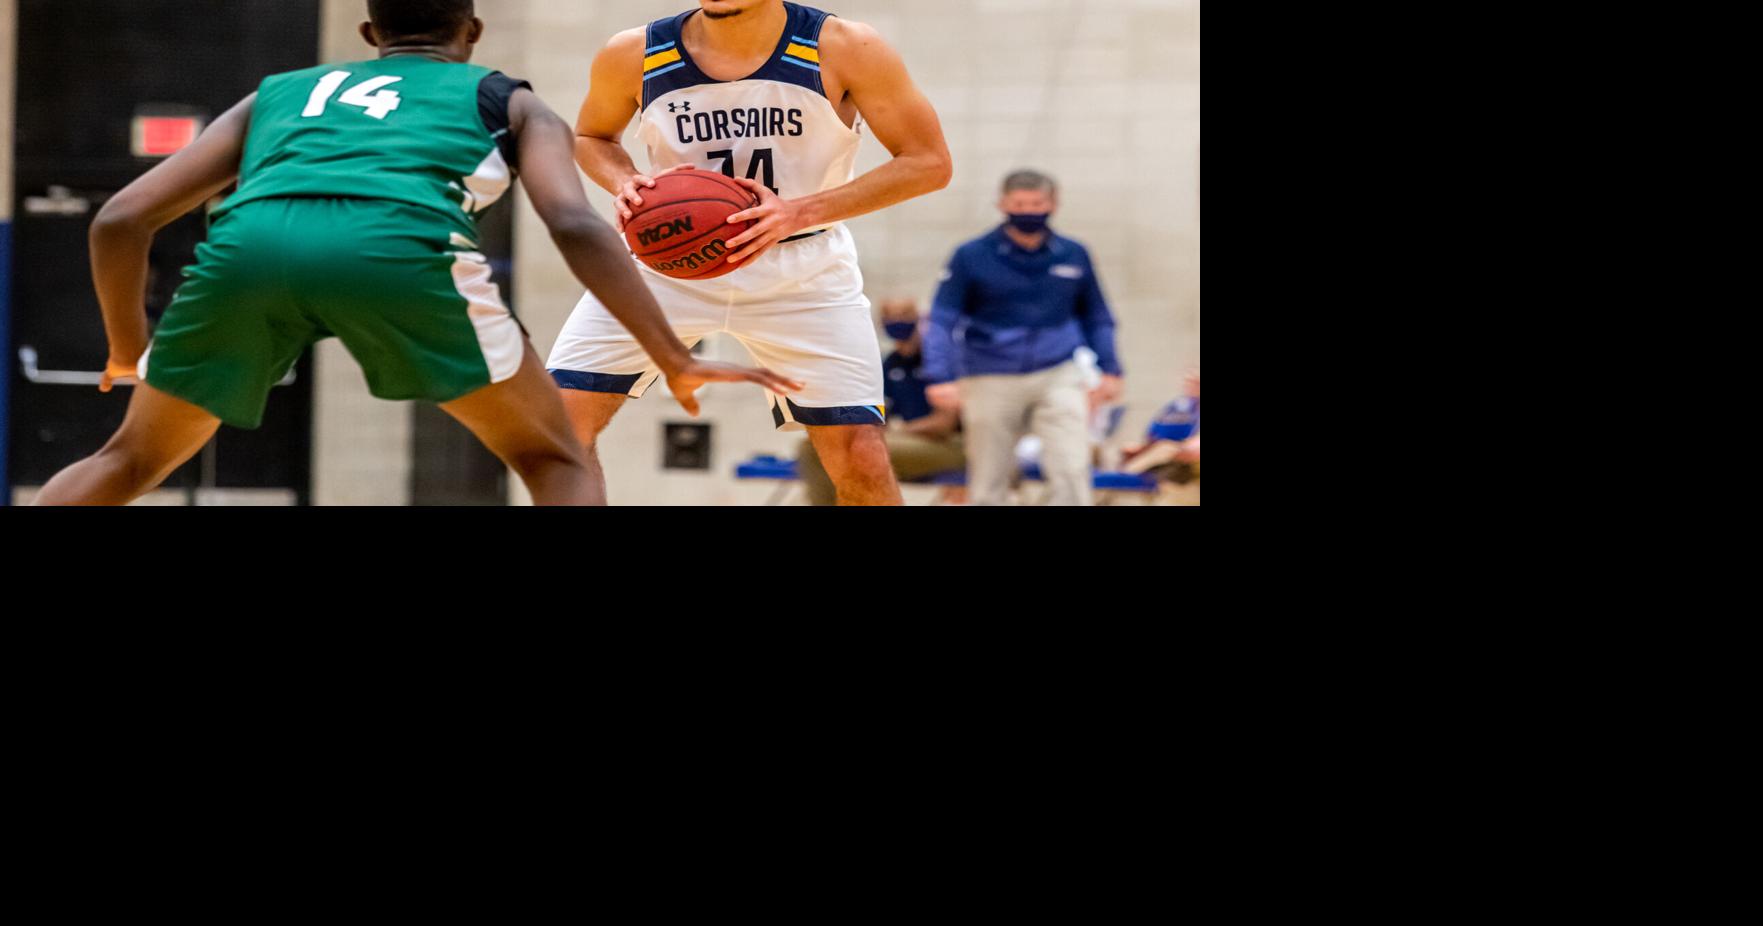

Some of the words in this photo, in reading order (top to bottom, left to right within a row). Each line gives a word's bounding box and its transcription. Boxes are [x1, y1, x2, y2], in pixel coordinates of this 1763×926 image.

[301, 70, 403, 120] 14
[676, 107, 803, 144] CORSAIRS
[637, 215, 693, 247] NCAA
